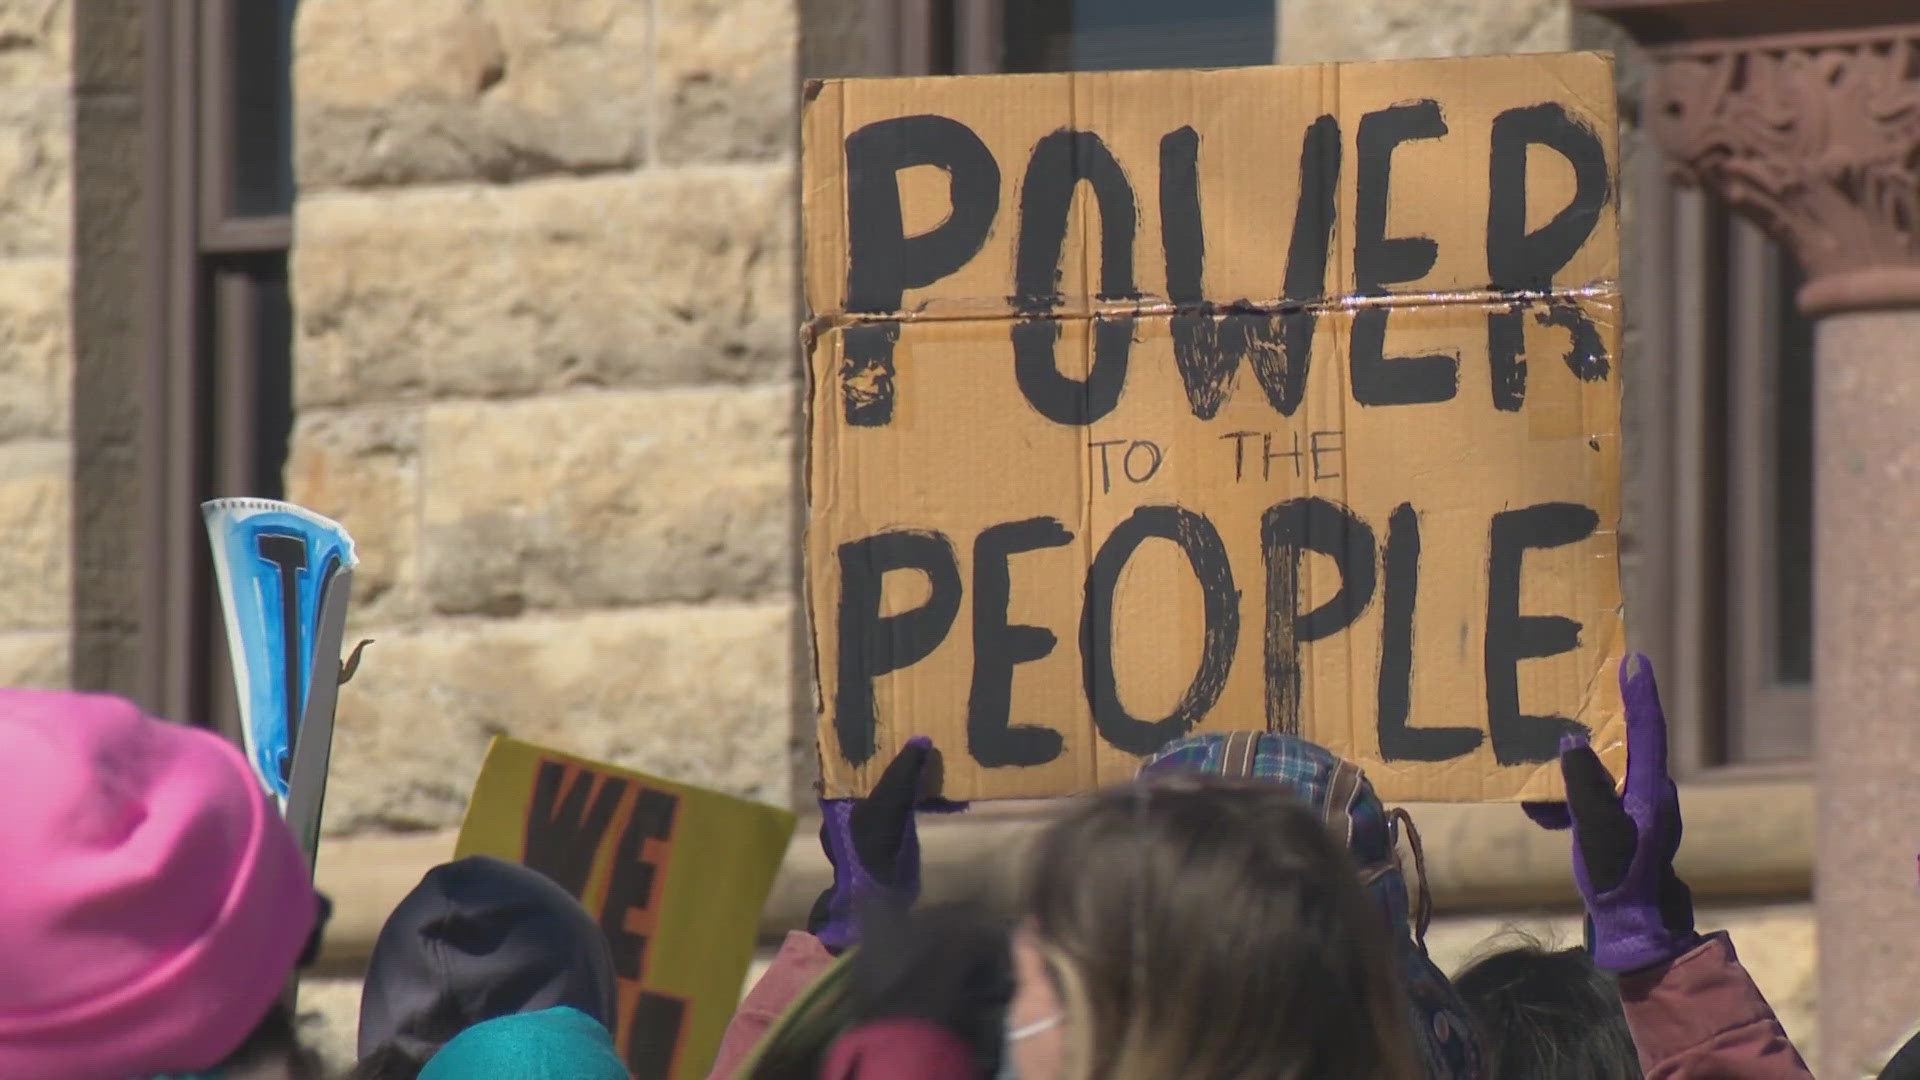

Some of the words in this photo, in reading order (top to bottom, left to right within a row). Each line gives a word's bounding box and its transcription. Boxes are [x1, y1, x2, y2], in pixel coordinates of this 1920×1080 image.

[842, 99, 1612, 427] POWER
[1089, 440, 1161, 494] TO
[1220, 431, 1344, 482] THE
[835, 498, 1599, 768] PEOPLE
